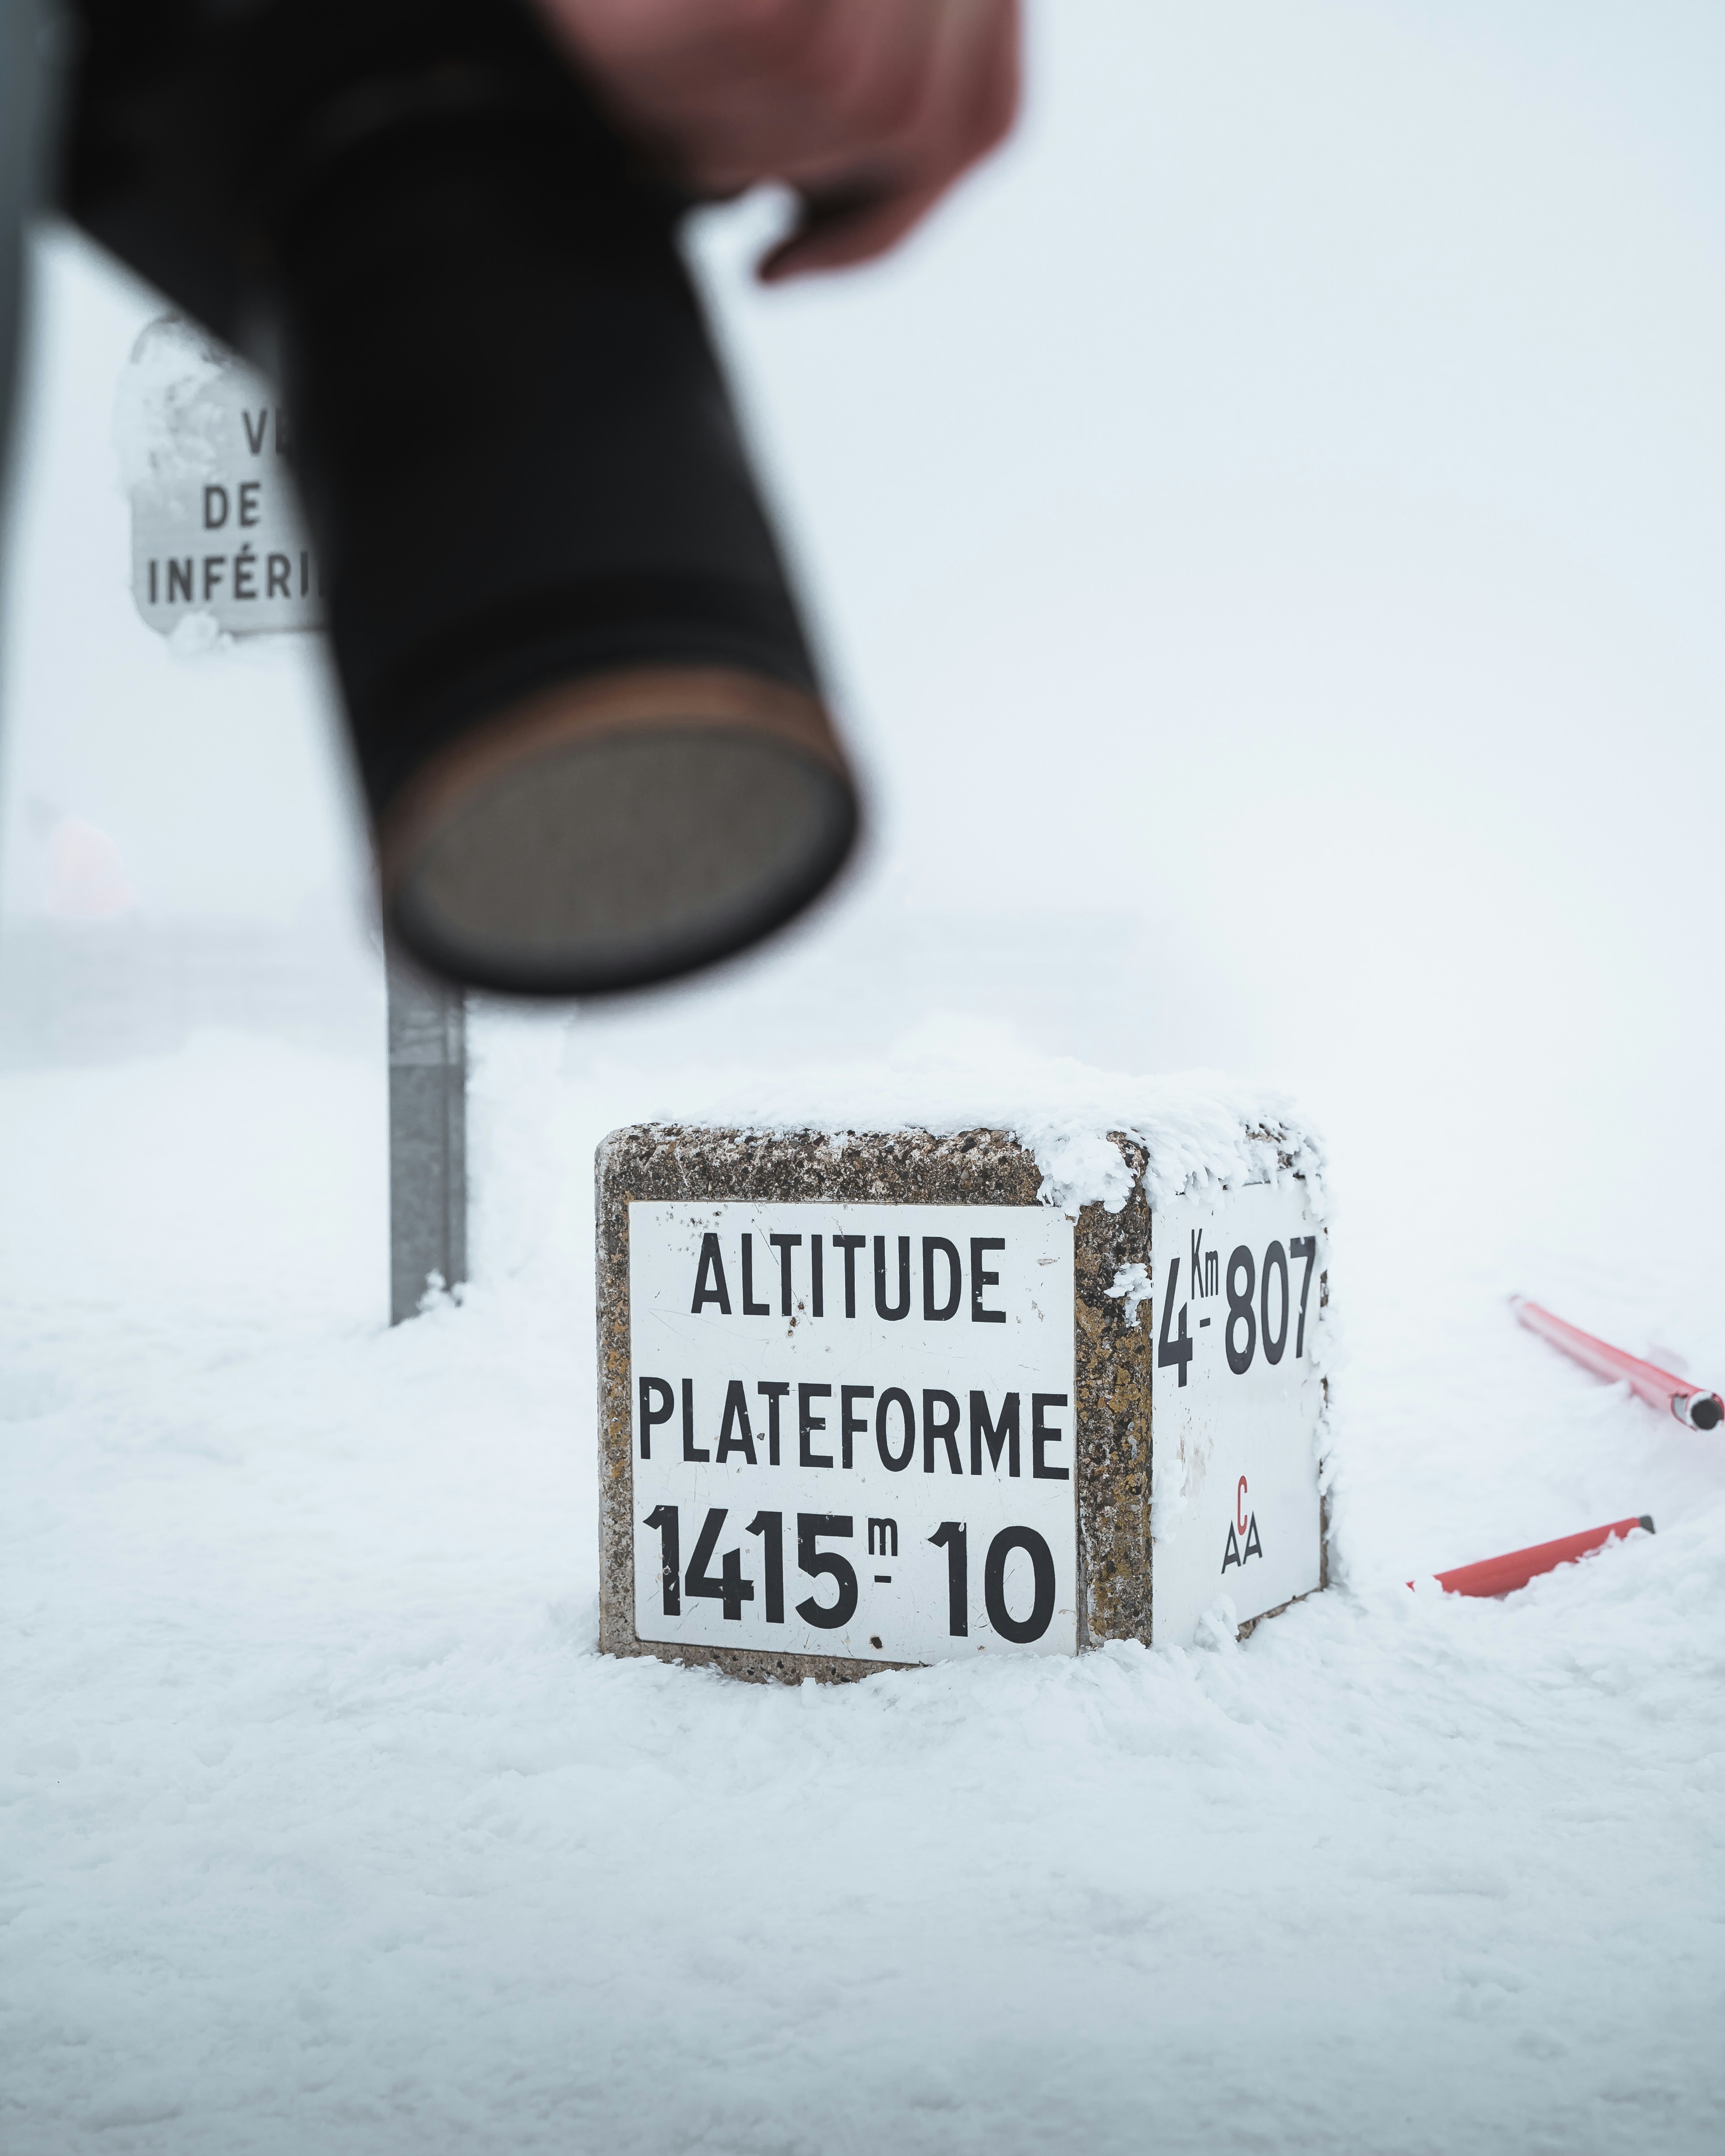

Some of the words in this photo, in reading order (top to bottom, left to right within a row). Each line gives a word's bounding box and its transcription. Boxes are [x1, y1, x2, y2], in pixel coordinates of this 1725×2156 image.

[204, 481, 261, 530] DE
[148, 543, 324, 605] INFÉRI
[691, 1232, 1007, 1323] ALTITUDE
[638, 1376, 1070, 1481] PLATEFORME
